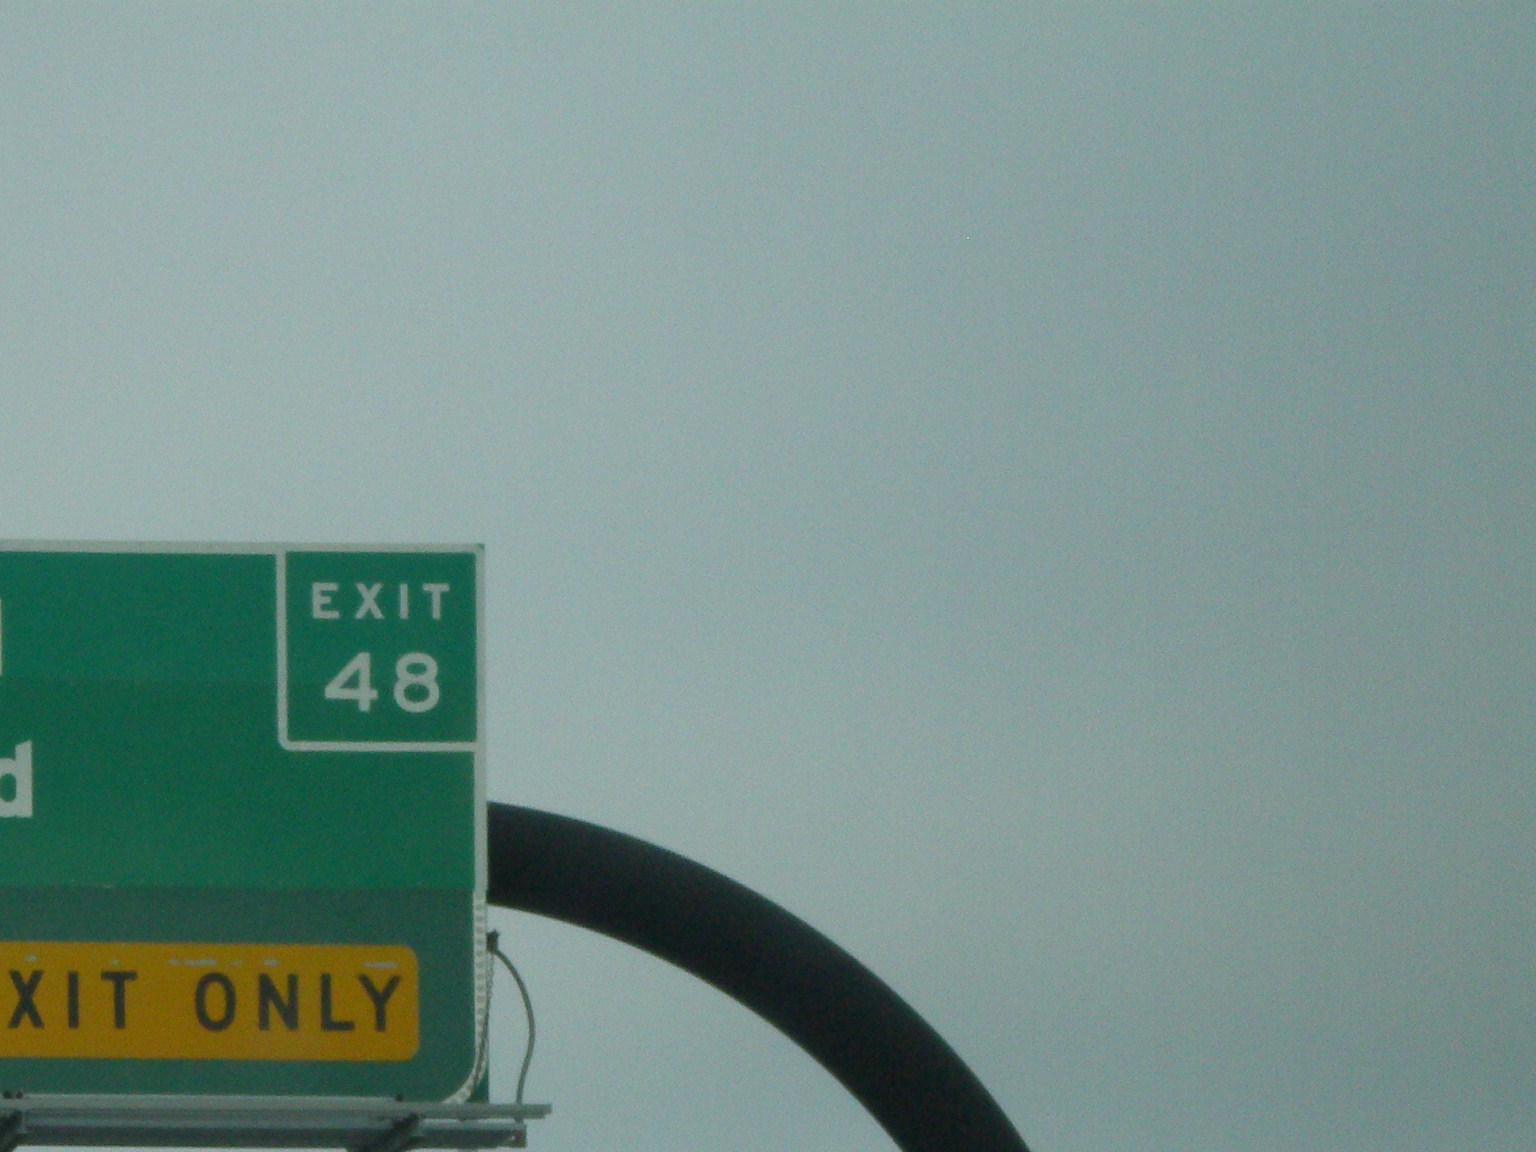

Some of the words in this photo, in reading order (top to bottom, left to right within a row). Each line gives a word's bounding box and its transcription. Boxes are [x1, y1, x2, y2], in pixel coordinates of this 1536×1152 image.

[310, 582, 451, 620] EXIT
[324, 651, 441, 713] 48
[194, 972, 402, 1033] ONLY
